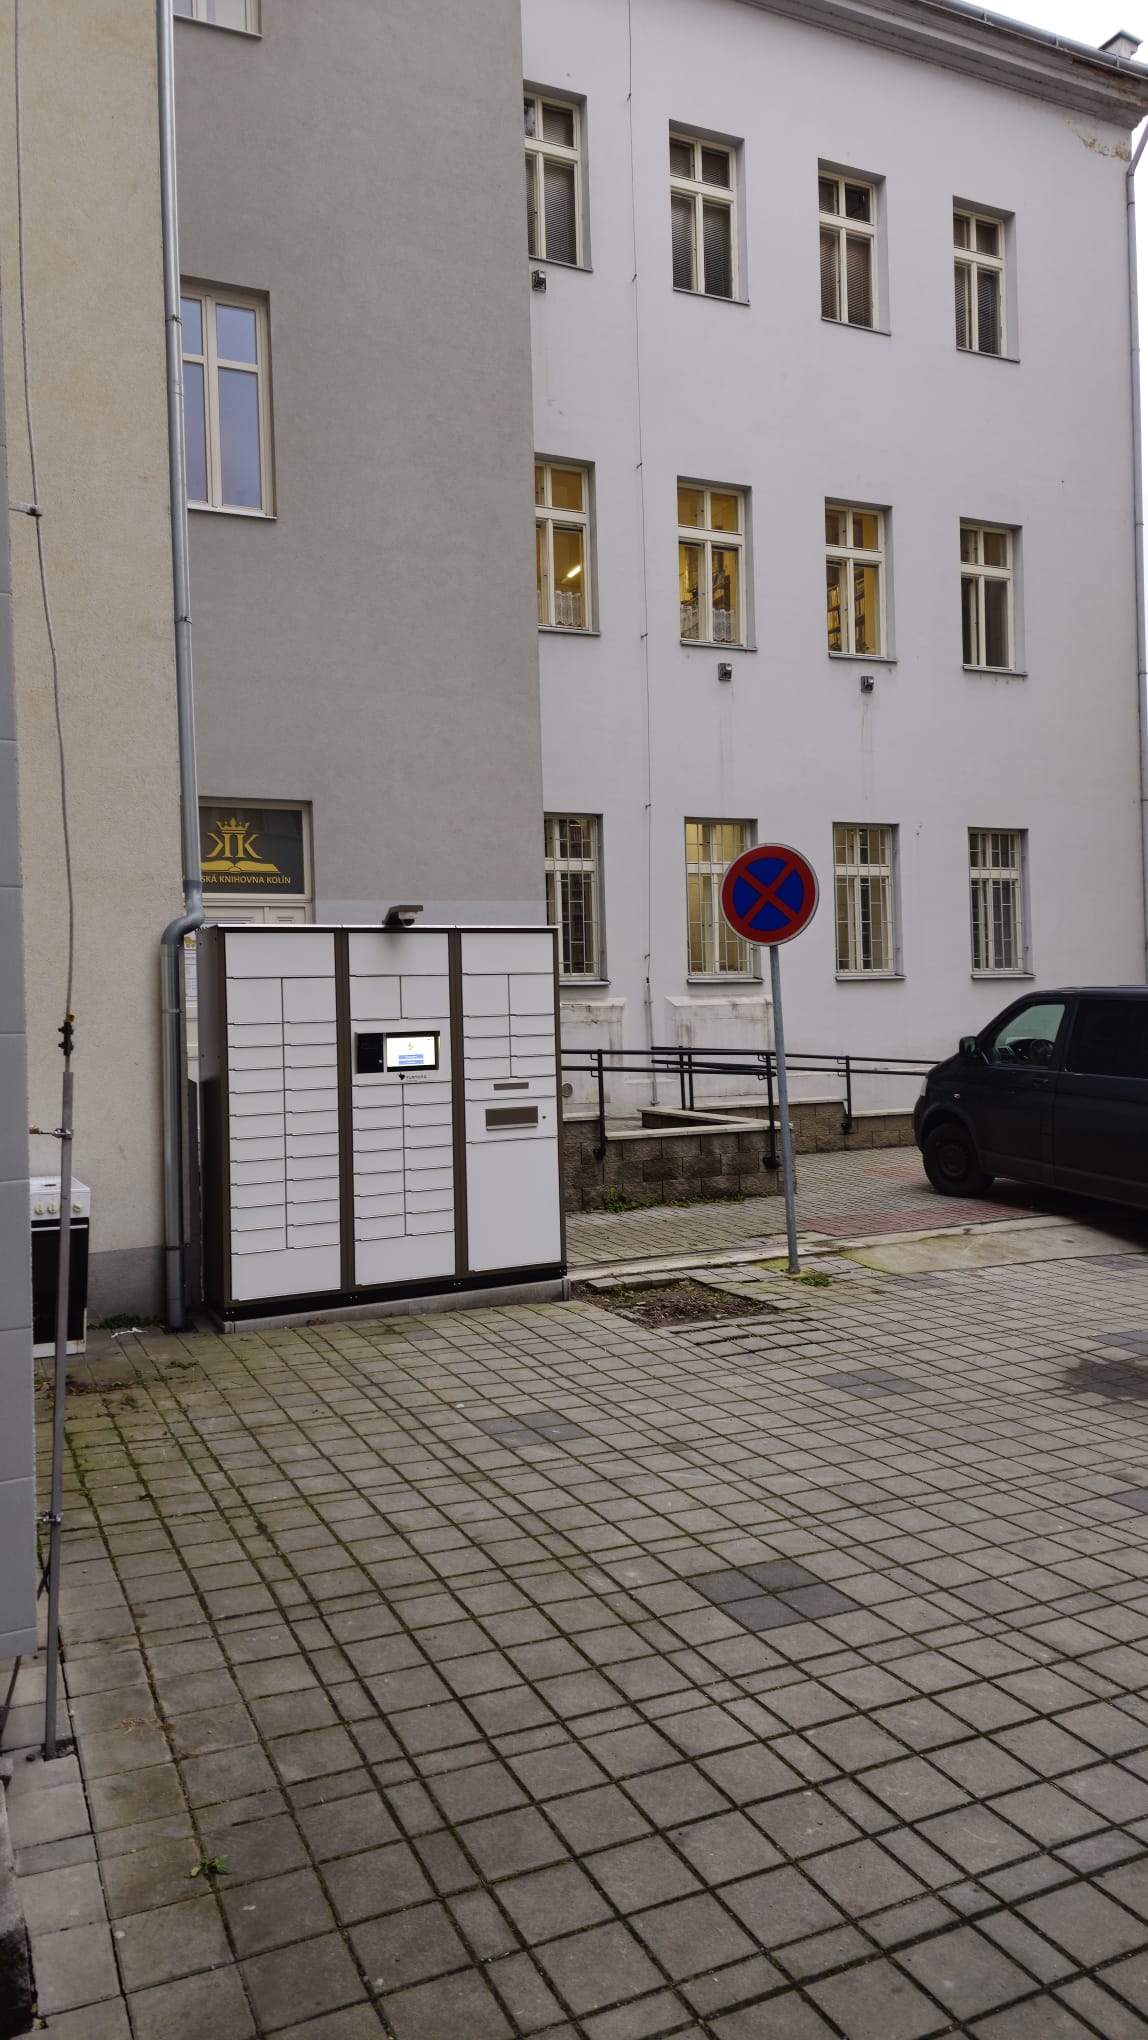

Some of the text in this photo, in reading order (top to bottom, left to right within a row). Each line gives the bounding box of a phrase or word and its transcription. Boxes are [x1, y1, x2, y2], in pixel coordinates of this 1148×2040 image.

[201, 874, 291, 884] SKÁ KNIHOVNA KOLÍN
